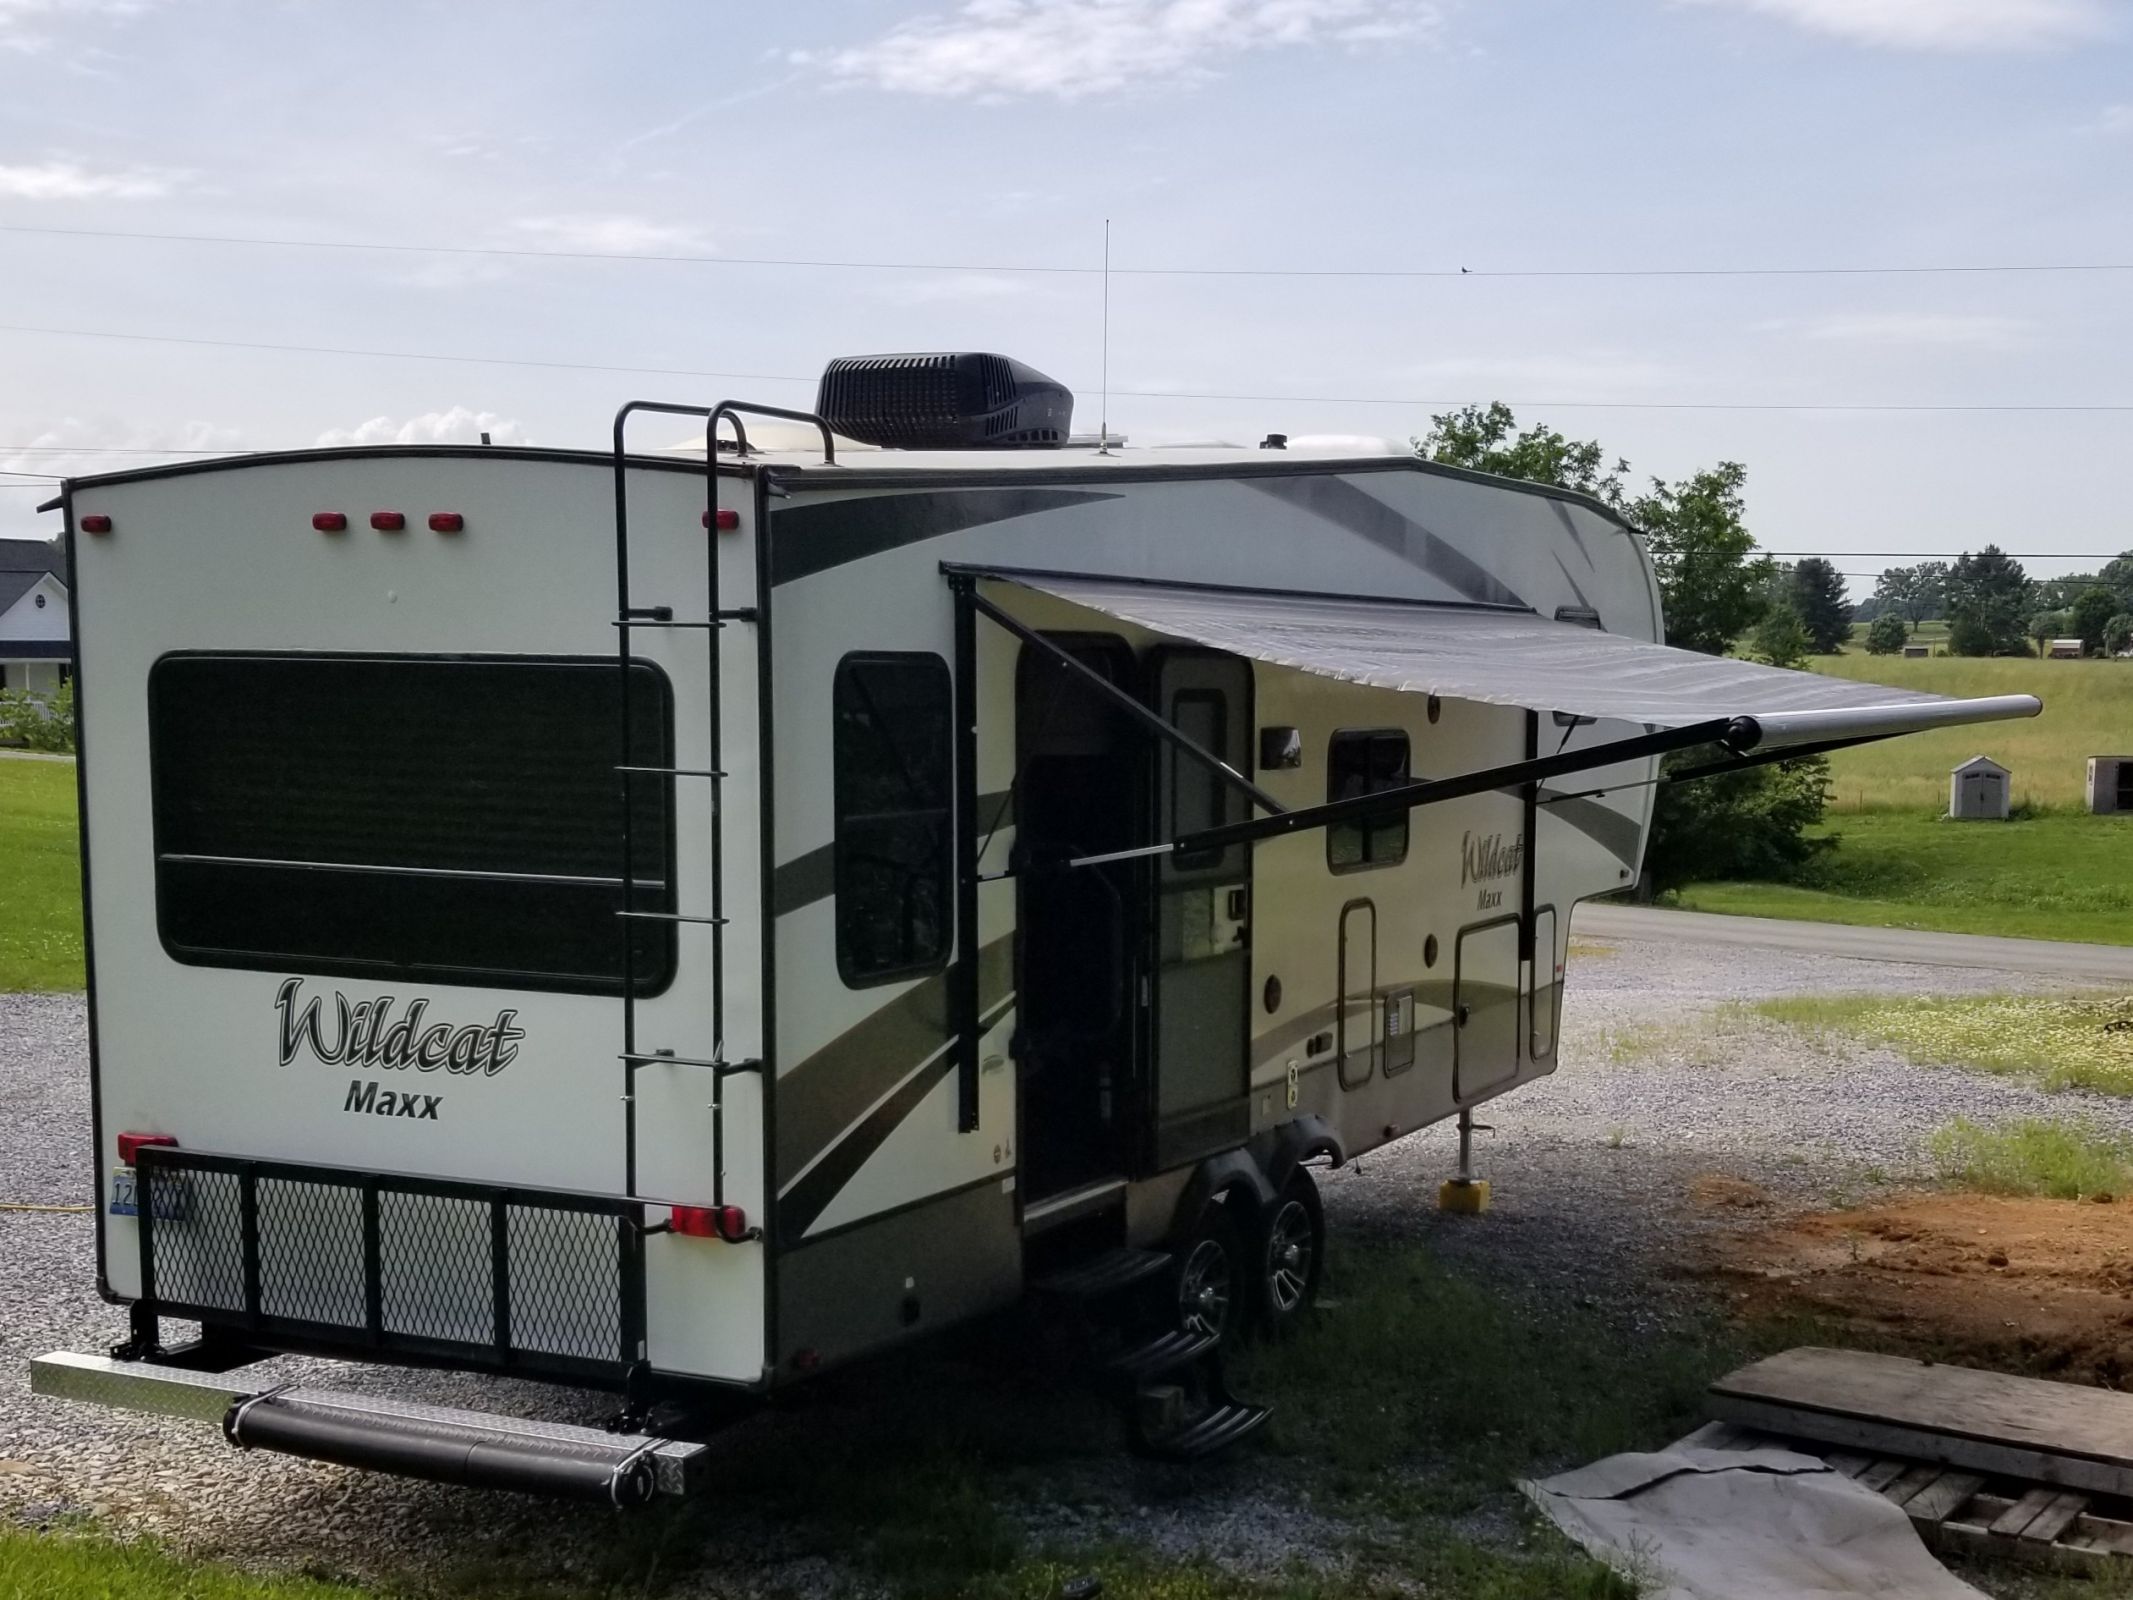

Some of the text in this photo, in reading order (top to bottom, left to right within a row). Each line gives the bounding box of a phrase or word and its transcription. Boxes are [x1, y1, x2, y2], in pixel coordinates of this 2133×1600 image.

[1460, 830, 1524, 889] Wildcat
[1477, 889, 1503, 911] Maxx
[274, 977, 526, 1077] Wildcat
[344, 1080, 443, 1120] Maxx
